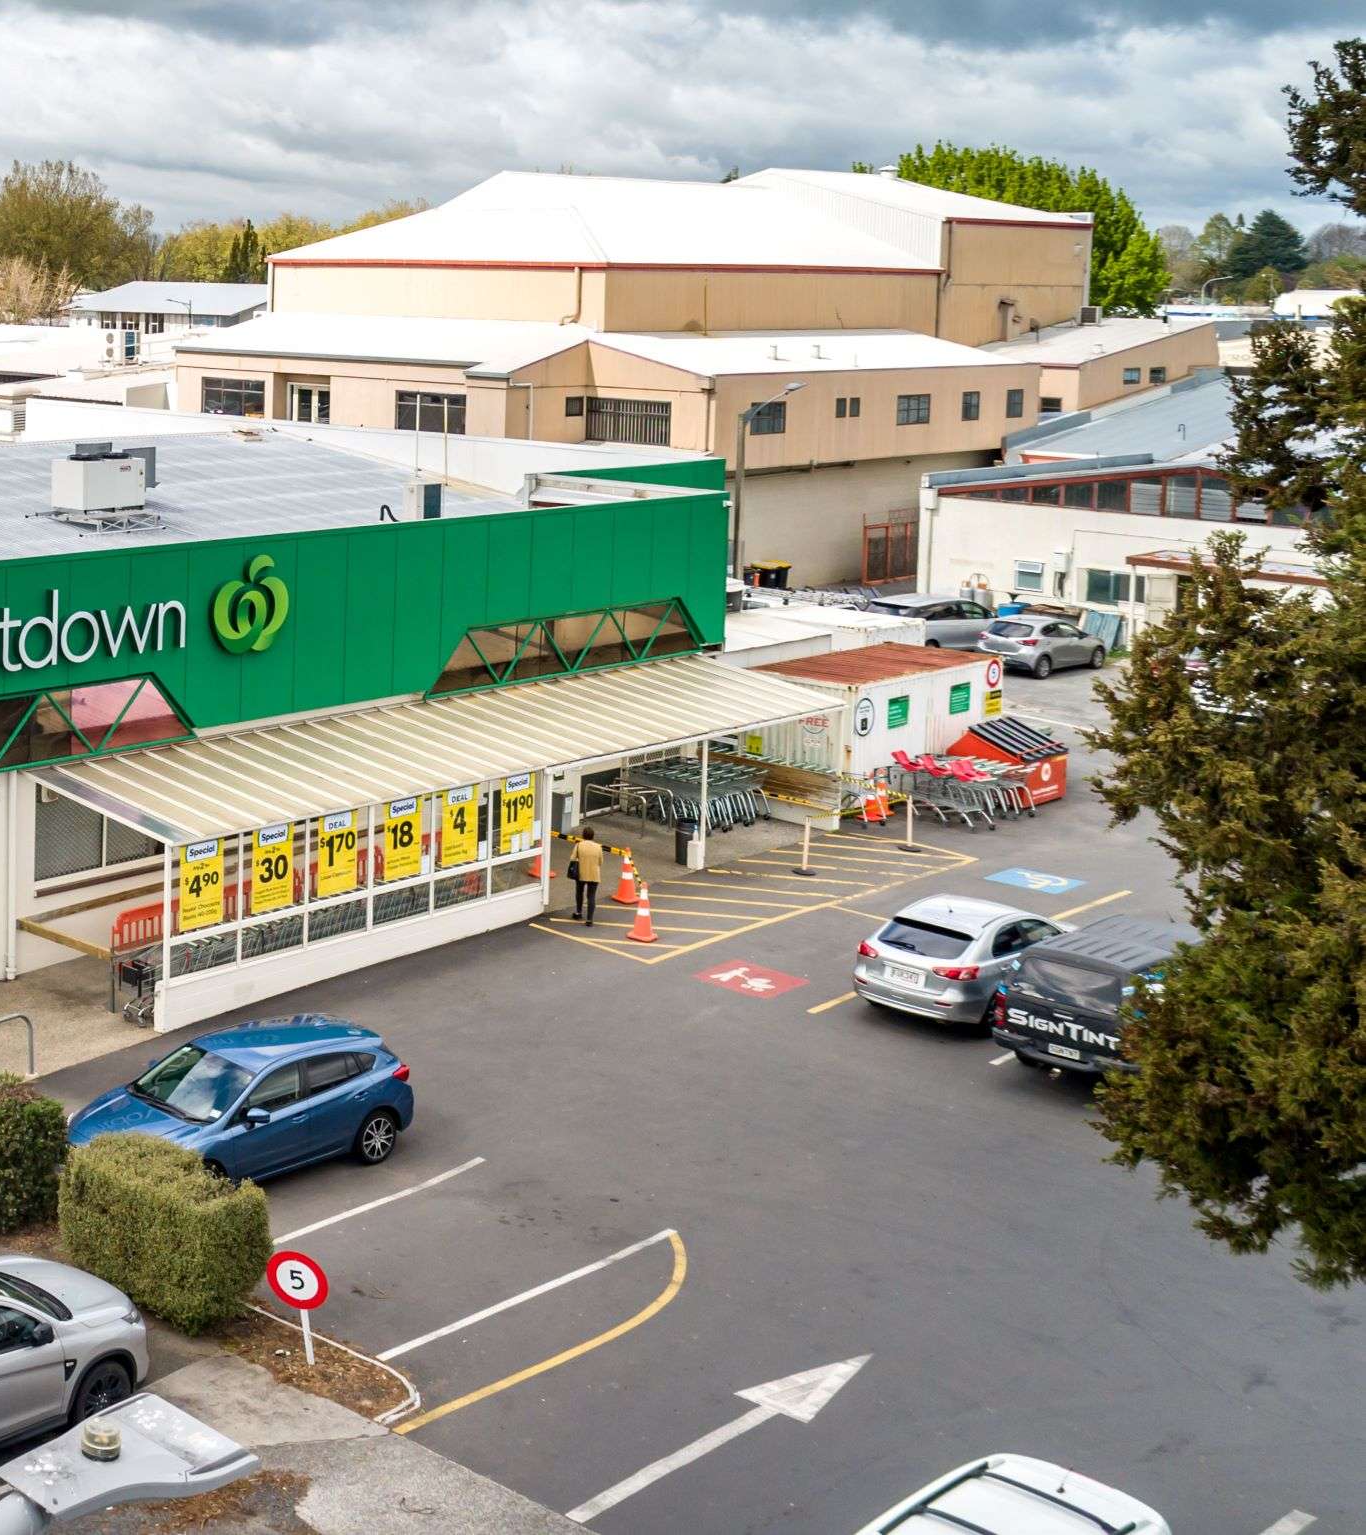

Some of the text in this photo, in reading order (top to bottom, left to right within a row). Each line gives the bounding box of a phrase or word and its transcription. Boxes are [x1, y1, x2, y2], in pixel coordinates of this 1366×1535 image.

[507, 777, 529, 789] Special
[451, 793, 468, 803] DEAL
[392, 801, 415, 814] Special
[328, 820, 346, 830] DEAL
[450, 806, 466, 835] $4
[261, 829, 286, 843] Special
[387, 820, 414, 850] $18
[189, 844, 215, 858] Special
[256, 854, 289, 883] $30
[289, 1269, 305, 1290] 5
